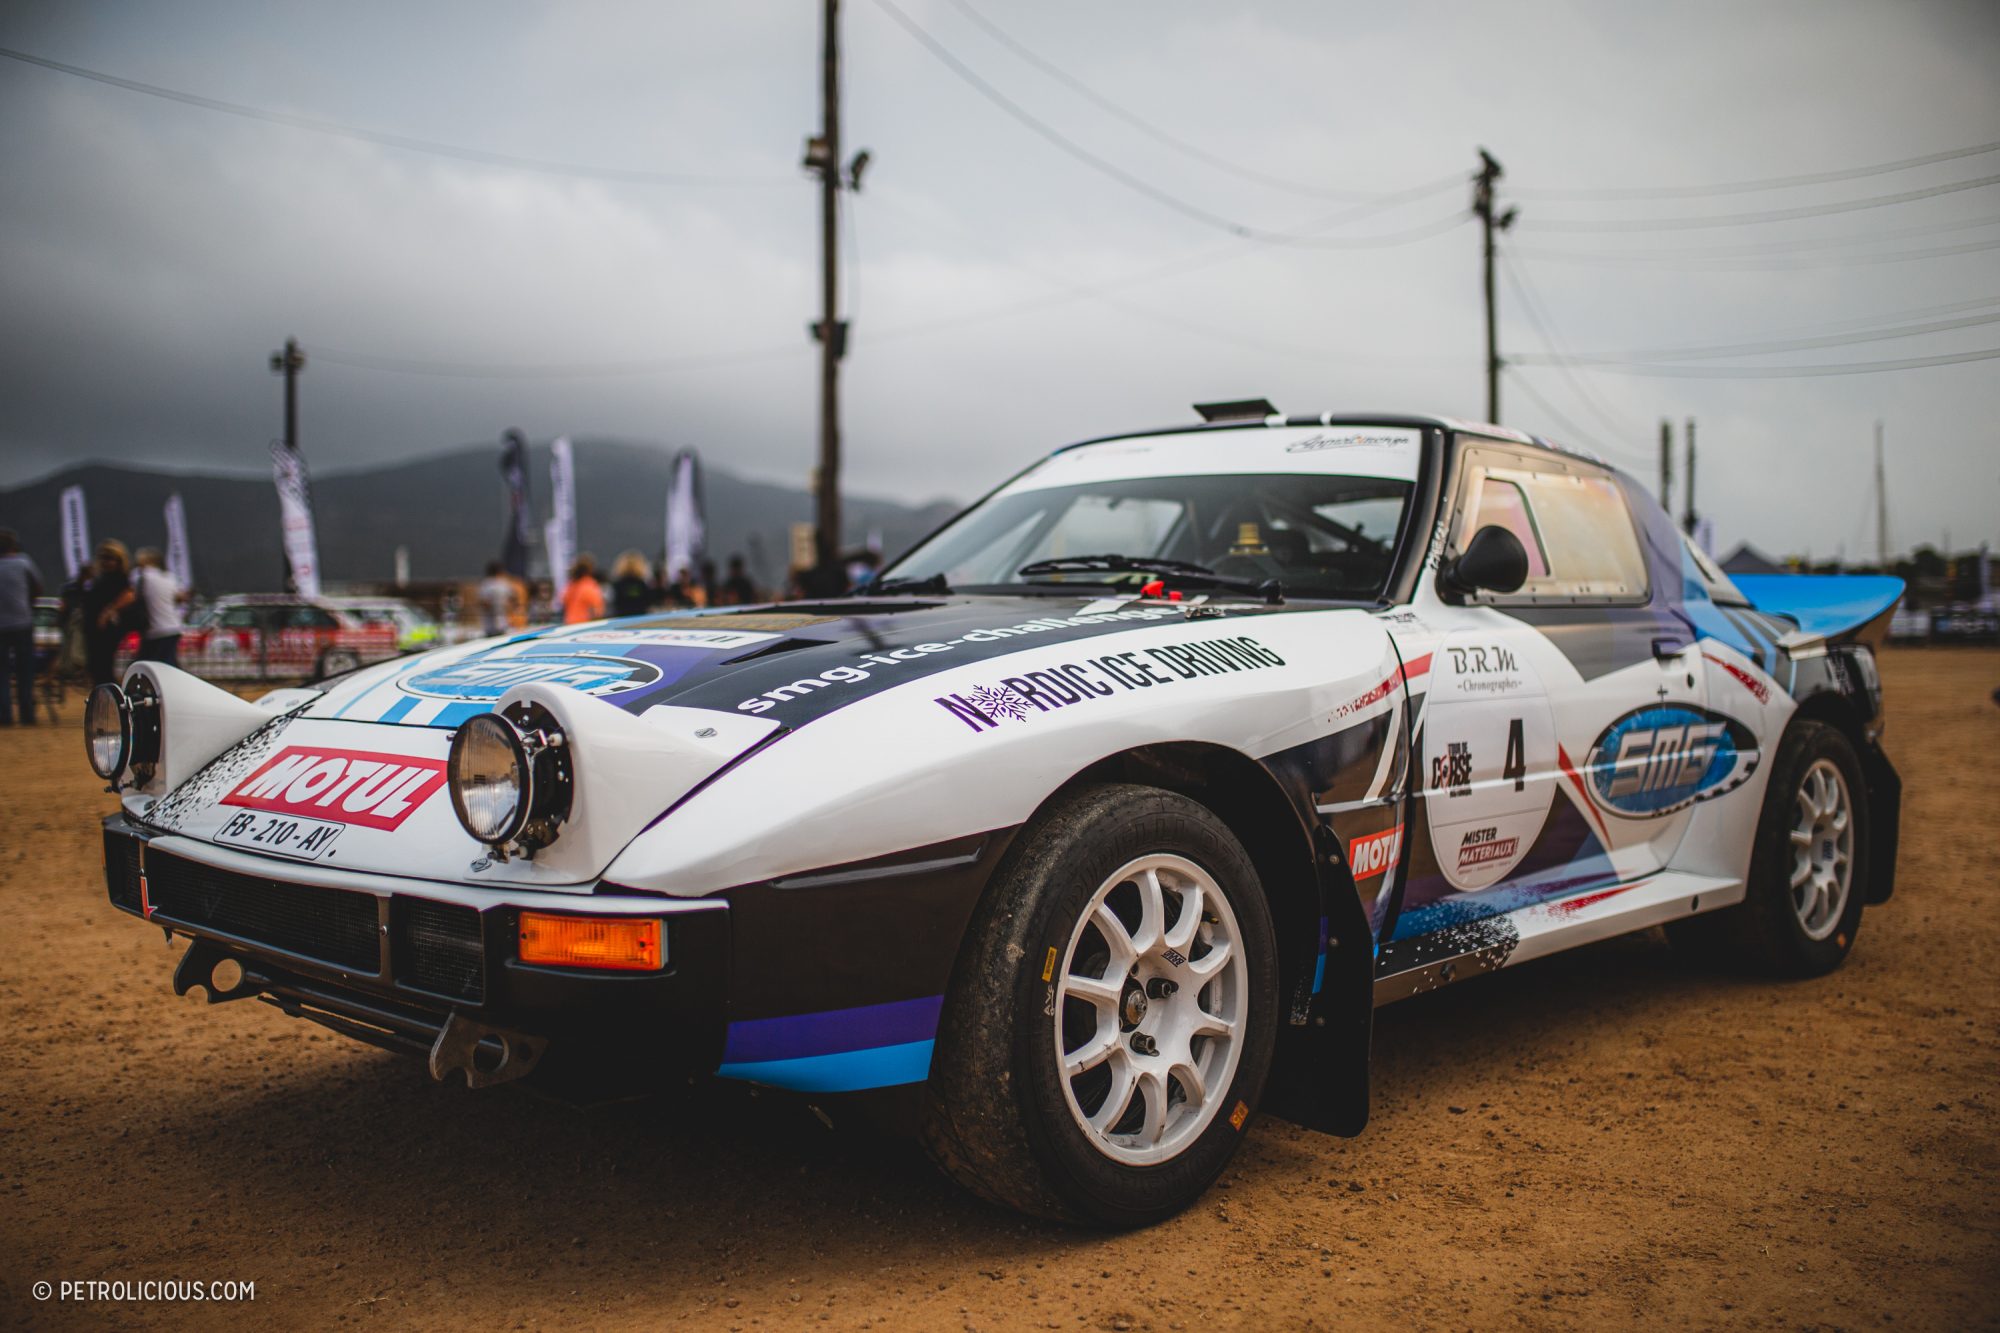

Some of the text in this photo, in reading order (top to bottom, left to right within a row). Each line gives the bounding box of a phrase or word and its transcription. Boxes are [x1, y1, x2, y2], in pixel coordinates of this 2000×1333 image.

[1086, 652, 1174, 690] ICE
[1143, 636, 1286, 679] DRIVING
[1503, 717, 1527, 792] 4
[1608, 721, 1727, 798] SMG
[236, 754, 441, 818] MOTUL
[1352, 831, 1403, 875] MOTU
[1459, 841, 1514, 864] MATERIAUX
[1462, 827, 1497, 846] MISTER
